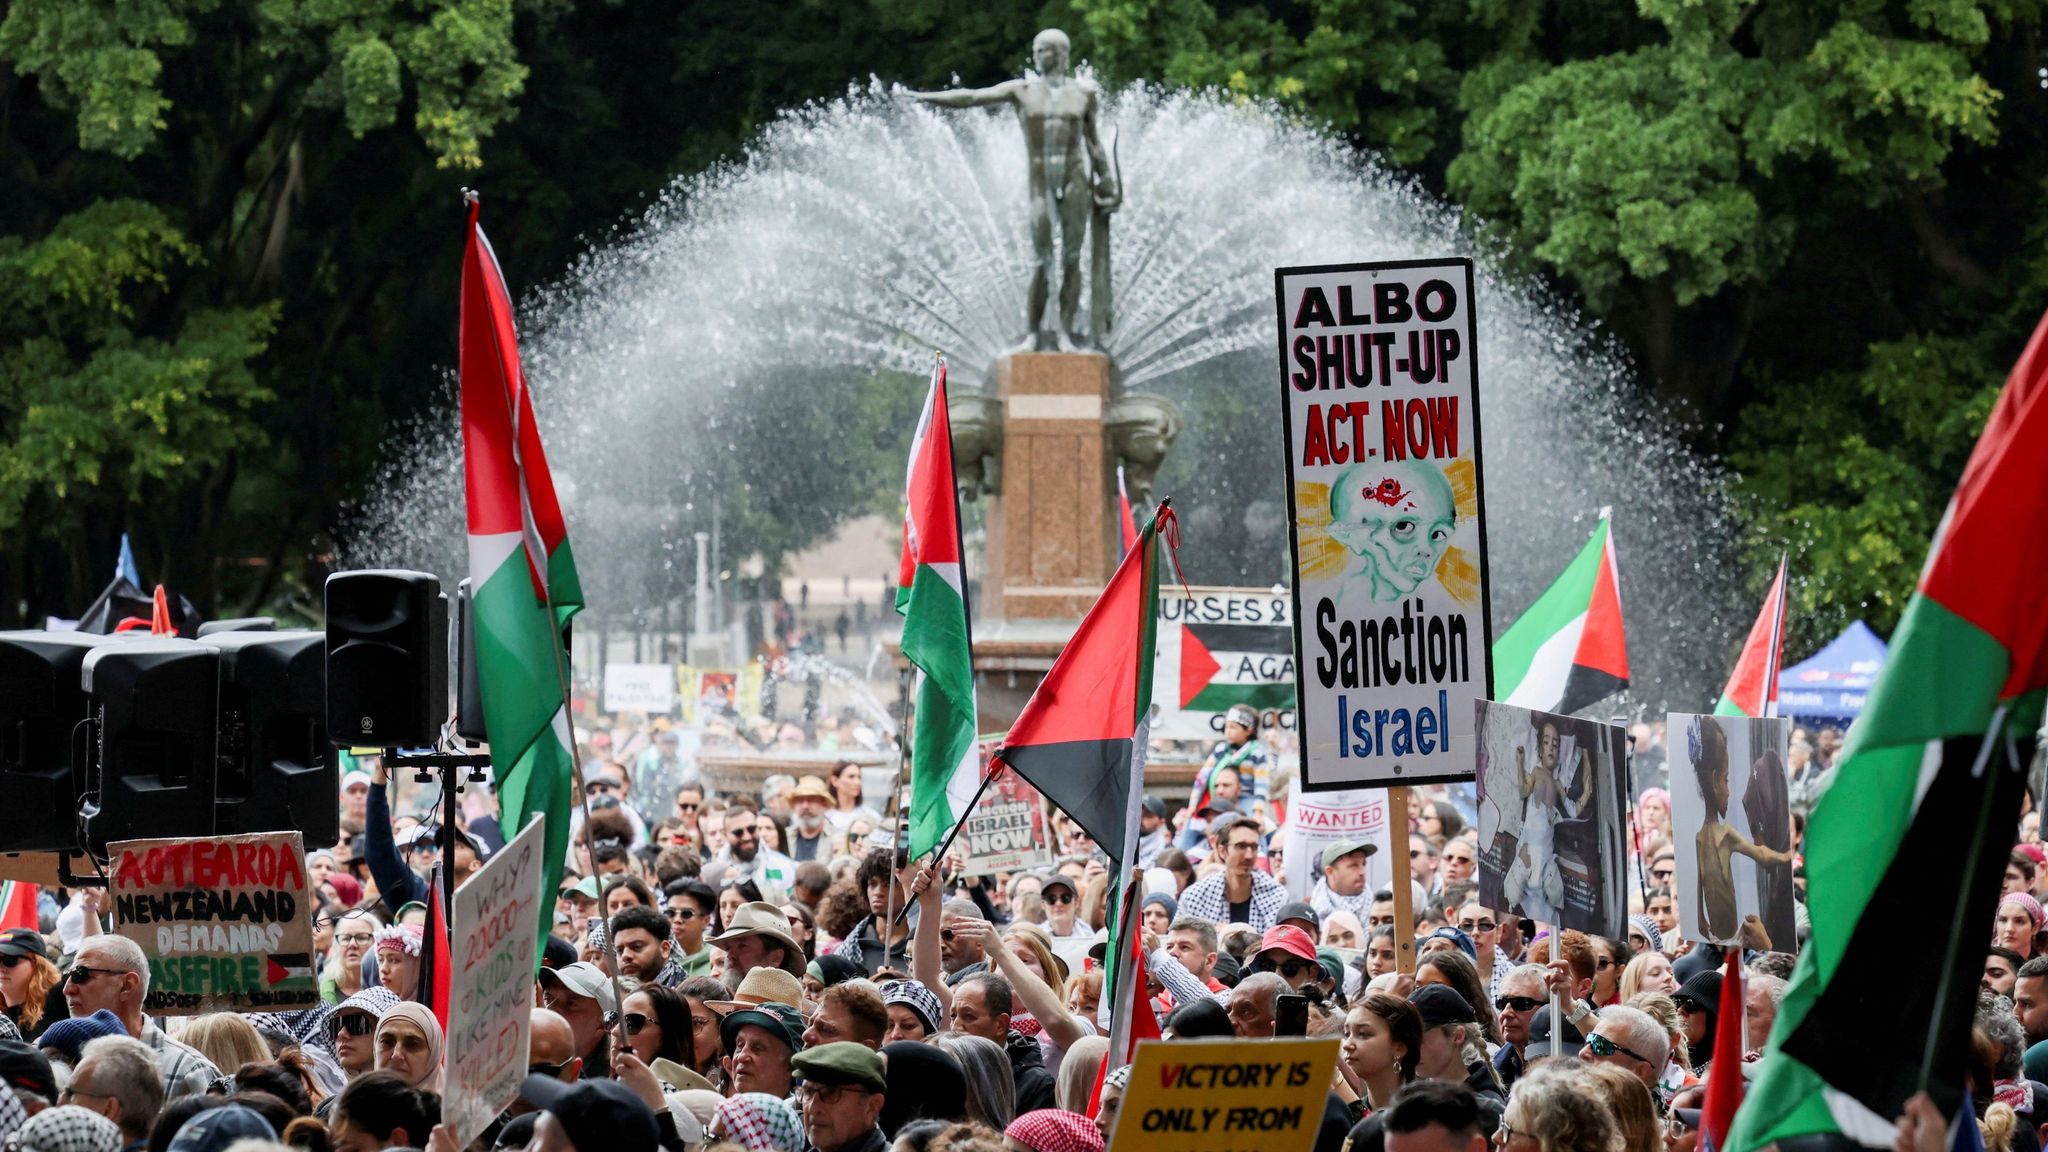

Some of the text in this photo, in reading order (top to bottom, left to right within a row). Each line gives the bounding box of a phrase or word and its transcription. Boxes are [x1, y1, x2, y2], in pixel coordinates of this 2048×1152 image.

[1294, 279, 1457, 329] ALBO
[1292, 328, 1461, 392] SHUT-UP
[1303, 395, 1459, 467] ACT. NOW
[1271, 599, 1285, 622] &
[1316, 597, 1469, 690] Sanction
[1338, 689, 1450, 759] Israel
[968, 814, 1030, 834] ISRAEL
[980, 801, 1030, 817] NCTION
[1299, 806, 1382, 827] WANTED
[971, 828, 1031, 855] NOW
[117, 842, 304, 890] AOTEAROA
[157, 923, 284, 956] DEMANDS
[148, 955, 261, 994] ASEFIRE
[475, 940, 515, 1008] KIDS
[1160, 1062, 1312, 1089] VICTORY IS
[1142, 1105, 1303, 1133] ONLY FROM
